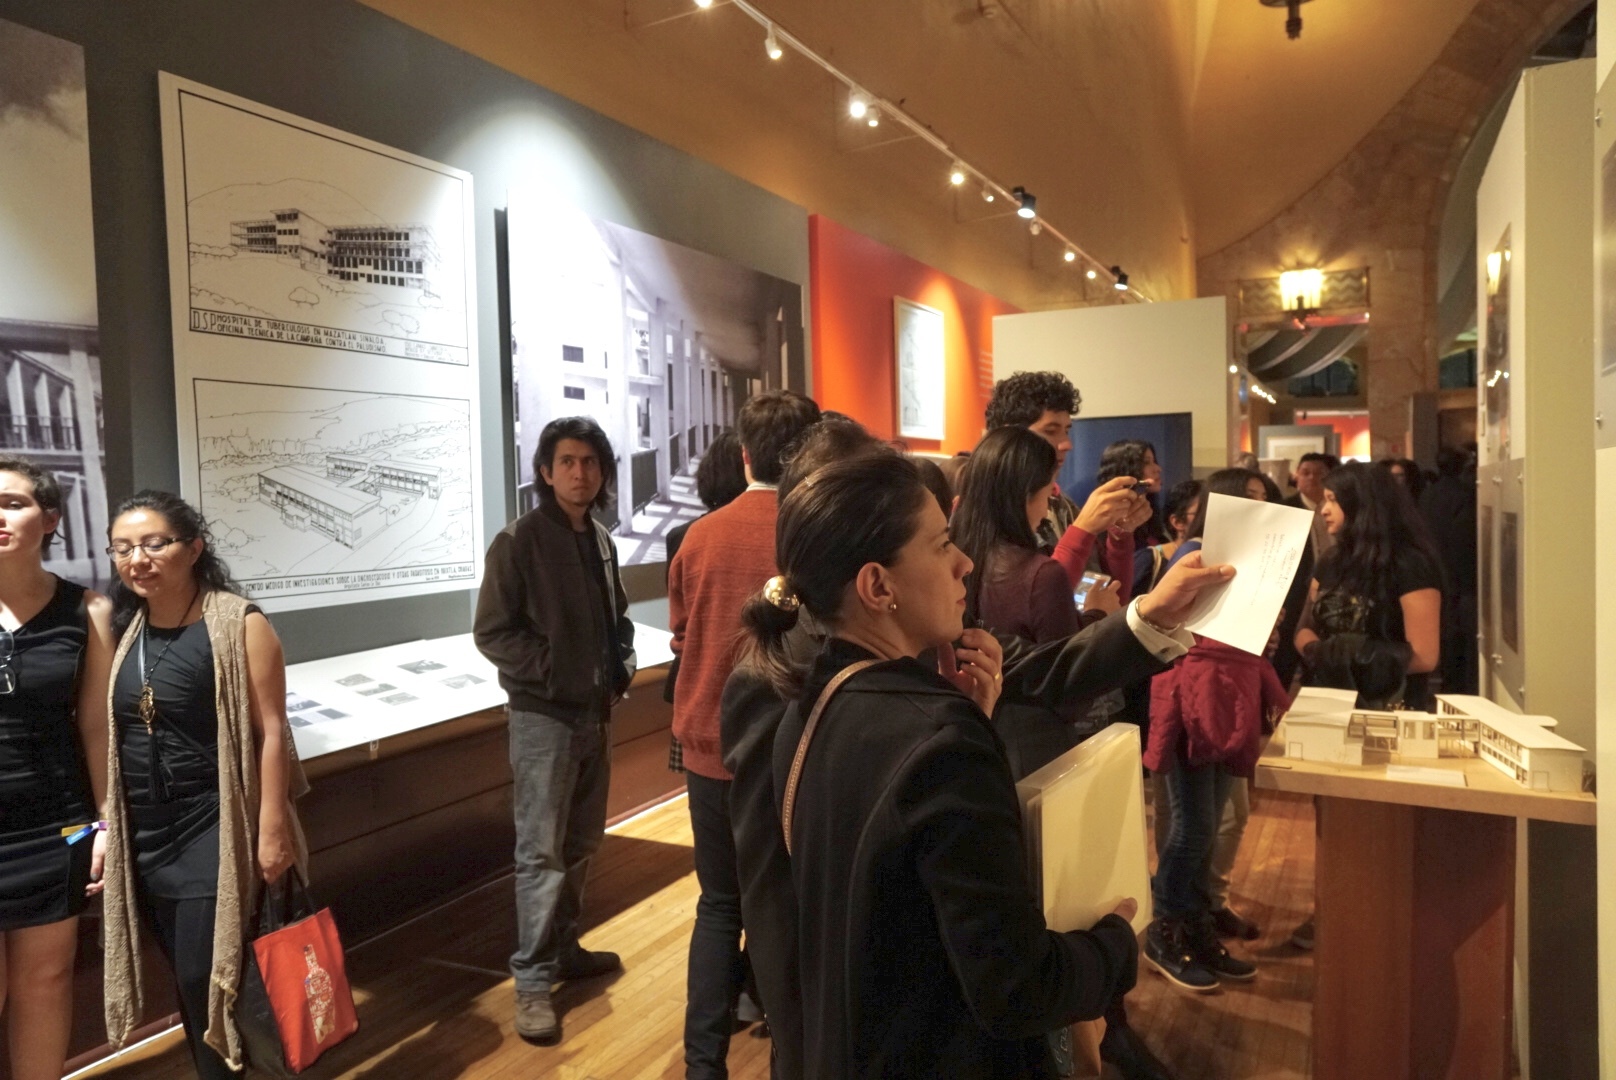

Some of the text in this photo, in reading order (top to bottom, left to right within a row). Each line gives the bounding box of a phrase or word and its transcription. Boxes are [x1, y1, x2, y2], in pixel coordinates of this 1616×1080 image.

[216, 315, 252, 327] HOSPITAL
[254, 320, 262, 328] DE
[266, 321, 310, 334] TUBERCULOSIS
[313, 328, 321, 336] EN
[323, 330, 357, 341] MAZATLAN
[216, 323, 244, 335] OFICINA
[247, 327, 274, 338] TECNICA
[276, 331, 284, 340] DE
[286, 333, 295, 341] LA
[325, 338, 347, 348] CONTRA
[348, 341, 354, 349] EL
[265, 580, 284, 590] MEDICO
[285, 580, 292, 588] DE
